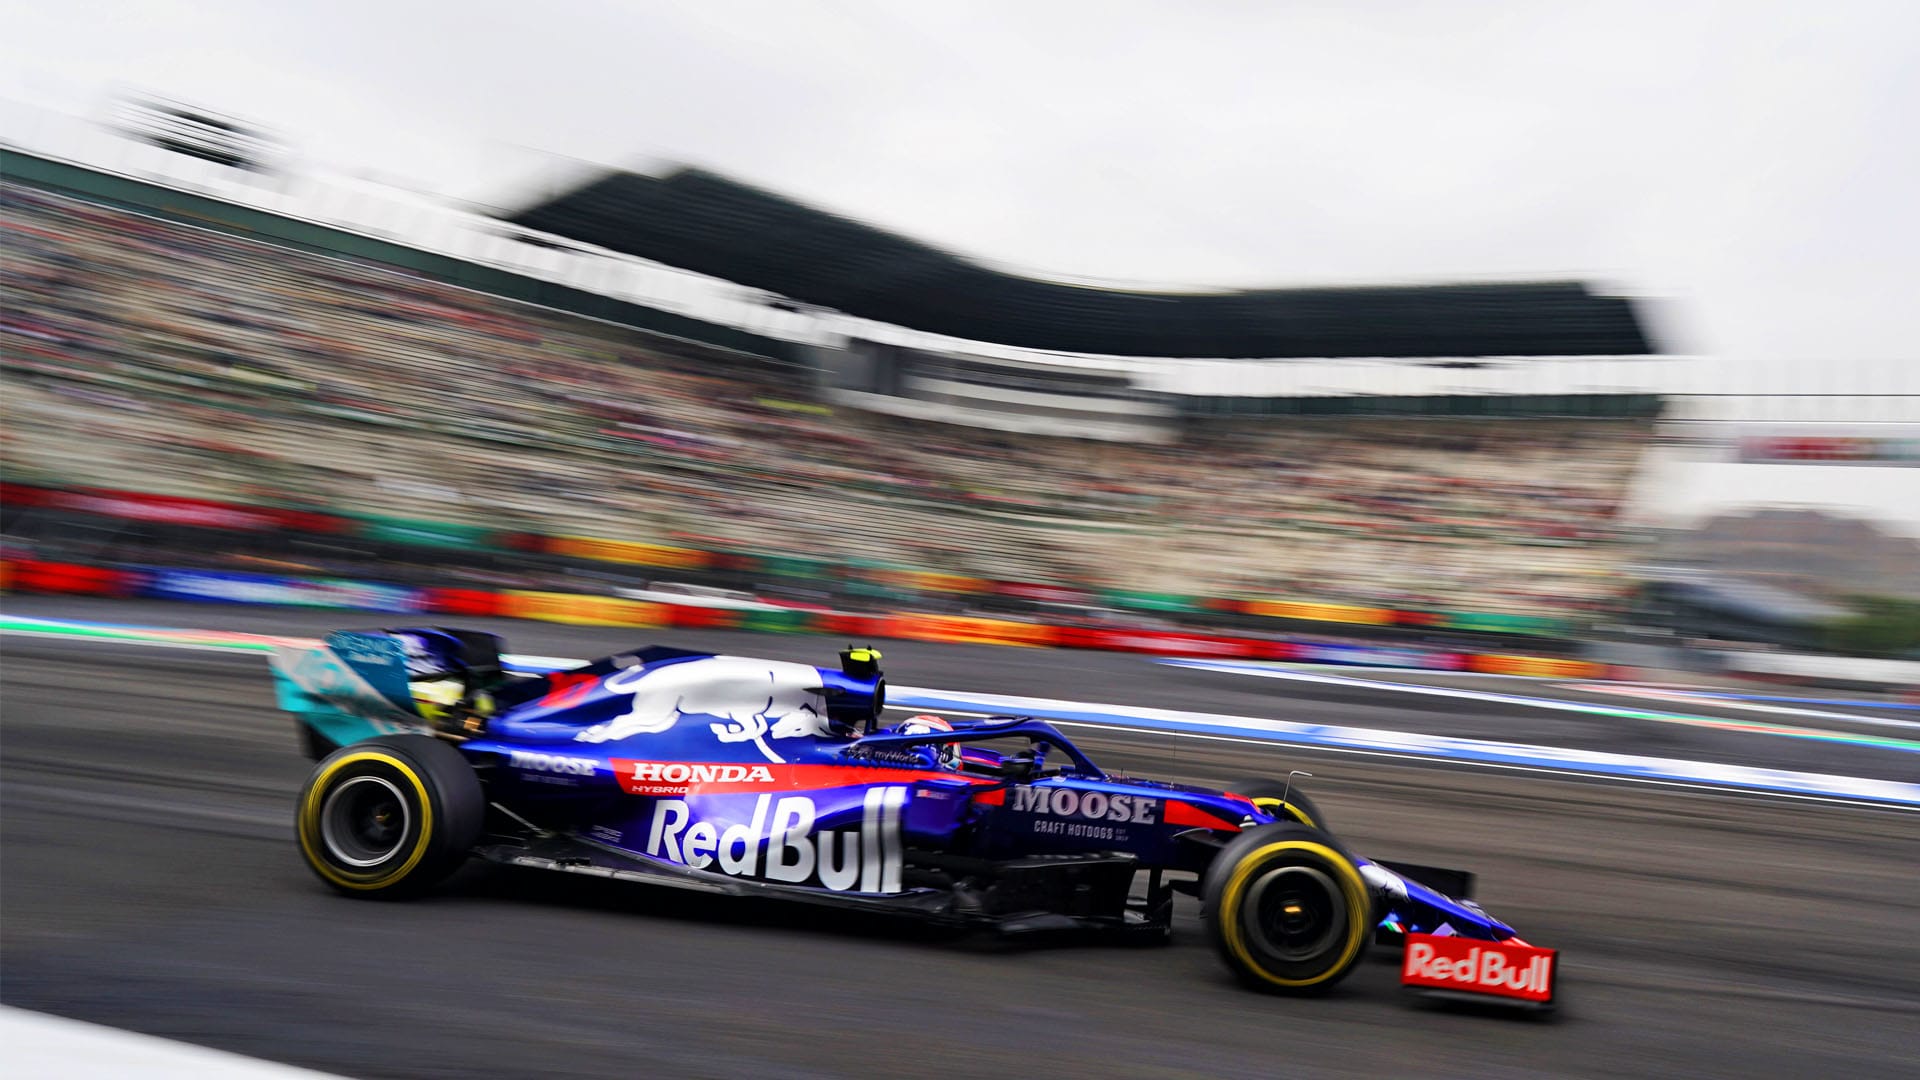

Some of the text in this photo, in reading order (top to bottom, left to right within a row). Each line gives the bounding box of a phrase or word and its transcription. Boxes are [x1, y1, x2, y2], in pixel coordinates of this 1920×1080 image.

[631, 762, 775, 783] HONDA
[632, 785, 690, 795] HYBRID
[1012, 783, 1157, 825] MOOSE
[1034, 820, 1066, 835] CRAFT
[1067, 823, 1113, 840] HOTDOGS
